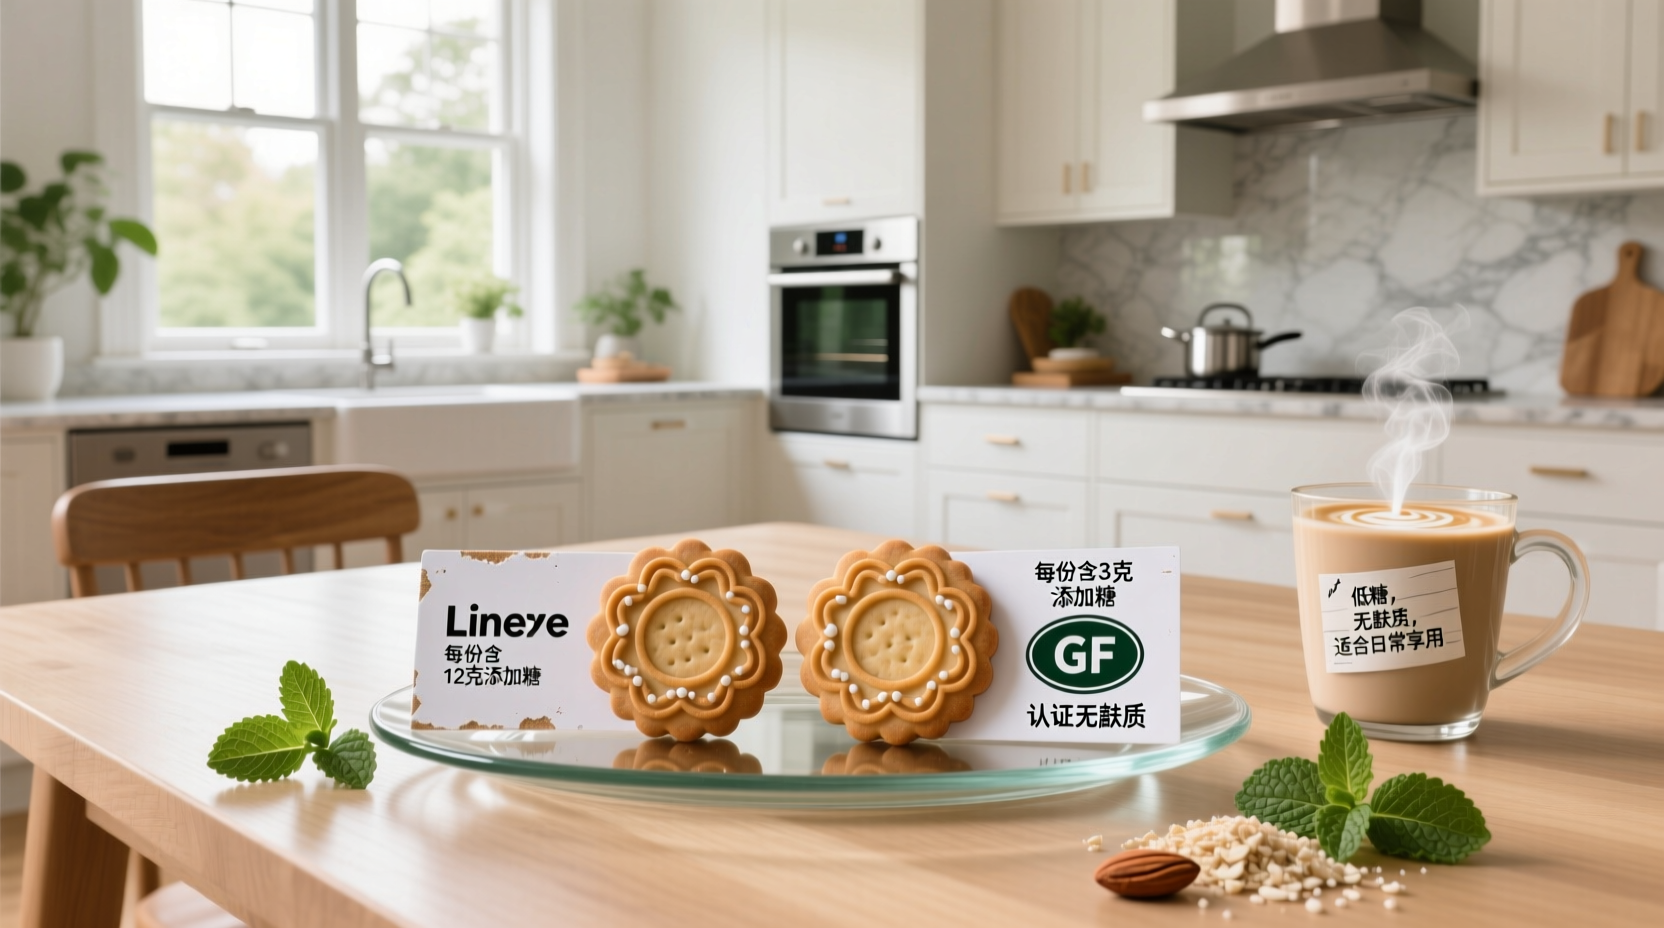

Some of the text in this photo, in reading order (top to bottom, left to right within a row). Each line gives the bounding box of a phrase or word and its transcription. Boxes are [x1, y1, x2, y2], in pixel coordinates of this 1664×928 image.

[1035, 560, 1134, 584] 每份含3克
[1051, 585, 1117, 608] 添加糖
[446, 603, 569, 638] Lineye
[444, 643, 502, 664] 每份含
[1333, 627, 1444, 657] 适合日常享用
[1054, 634, 1116, 675] GF
[443, 664, 542, 687] 12克添加糖
